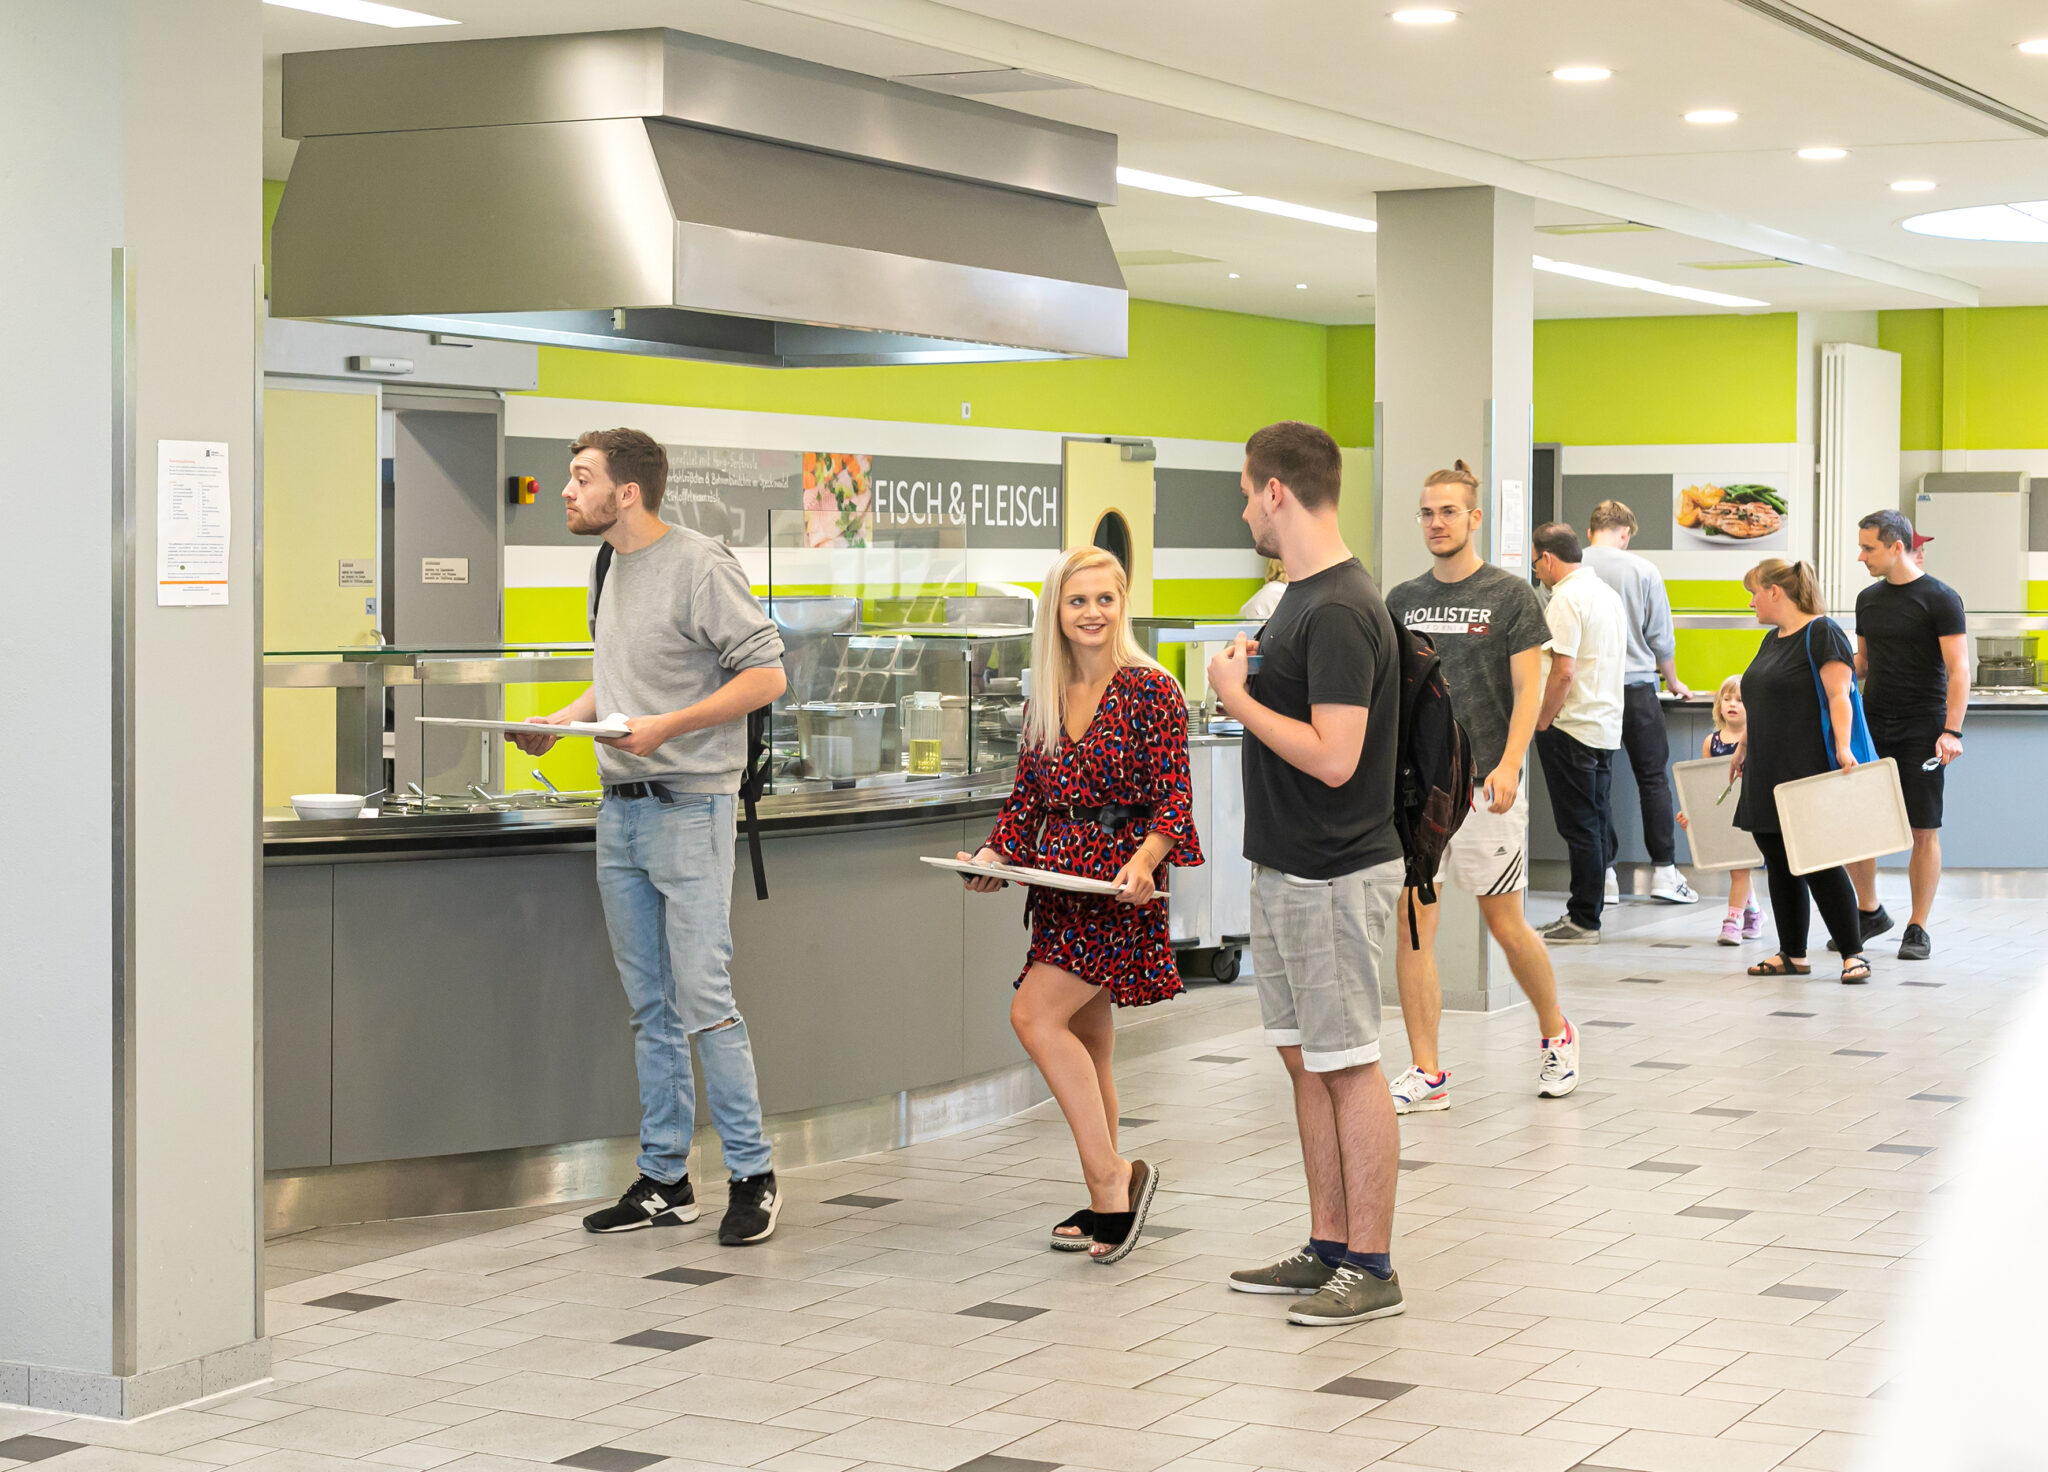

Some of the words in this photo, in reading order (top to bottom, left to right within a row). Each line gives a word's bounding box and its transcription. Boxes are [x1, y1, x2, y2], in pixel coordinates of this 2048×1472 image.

[875, 480, 943, 525] FISCH
[949, 481, 967, 526] &
[972, 483, 1057, 527] FLEISCH
[1404, 606, 1492, 626] HOLLISTER
